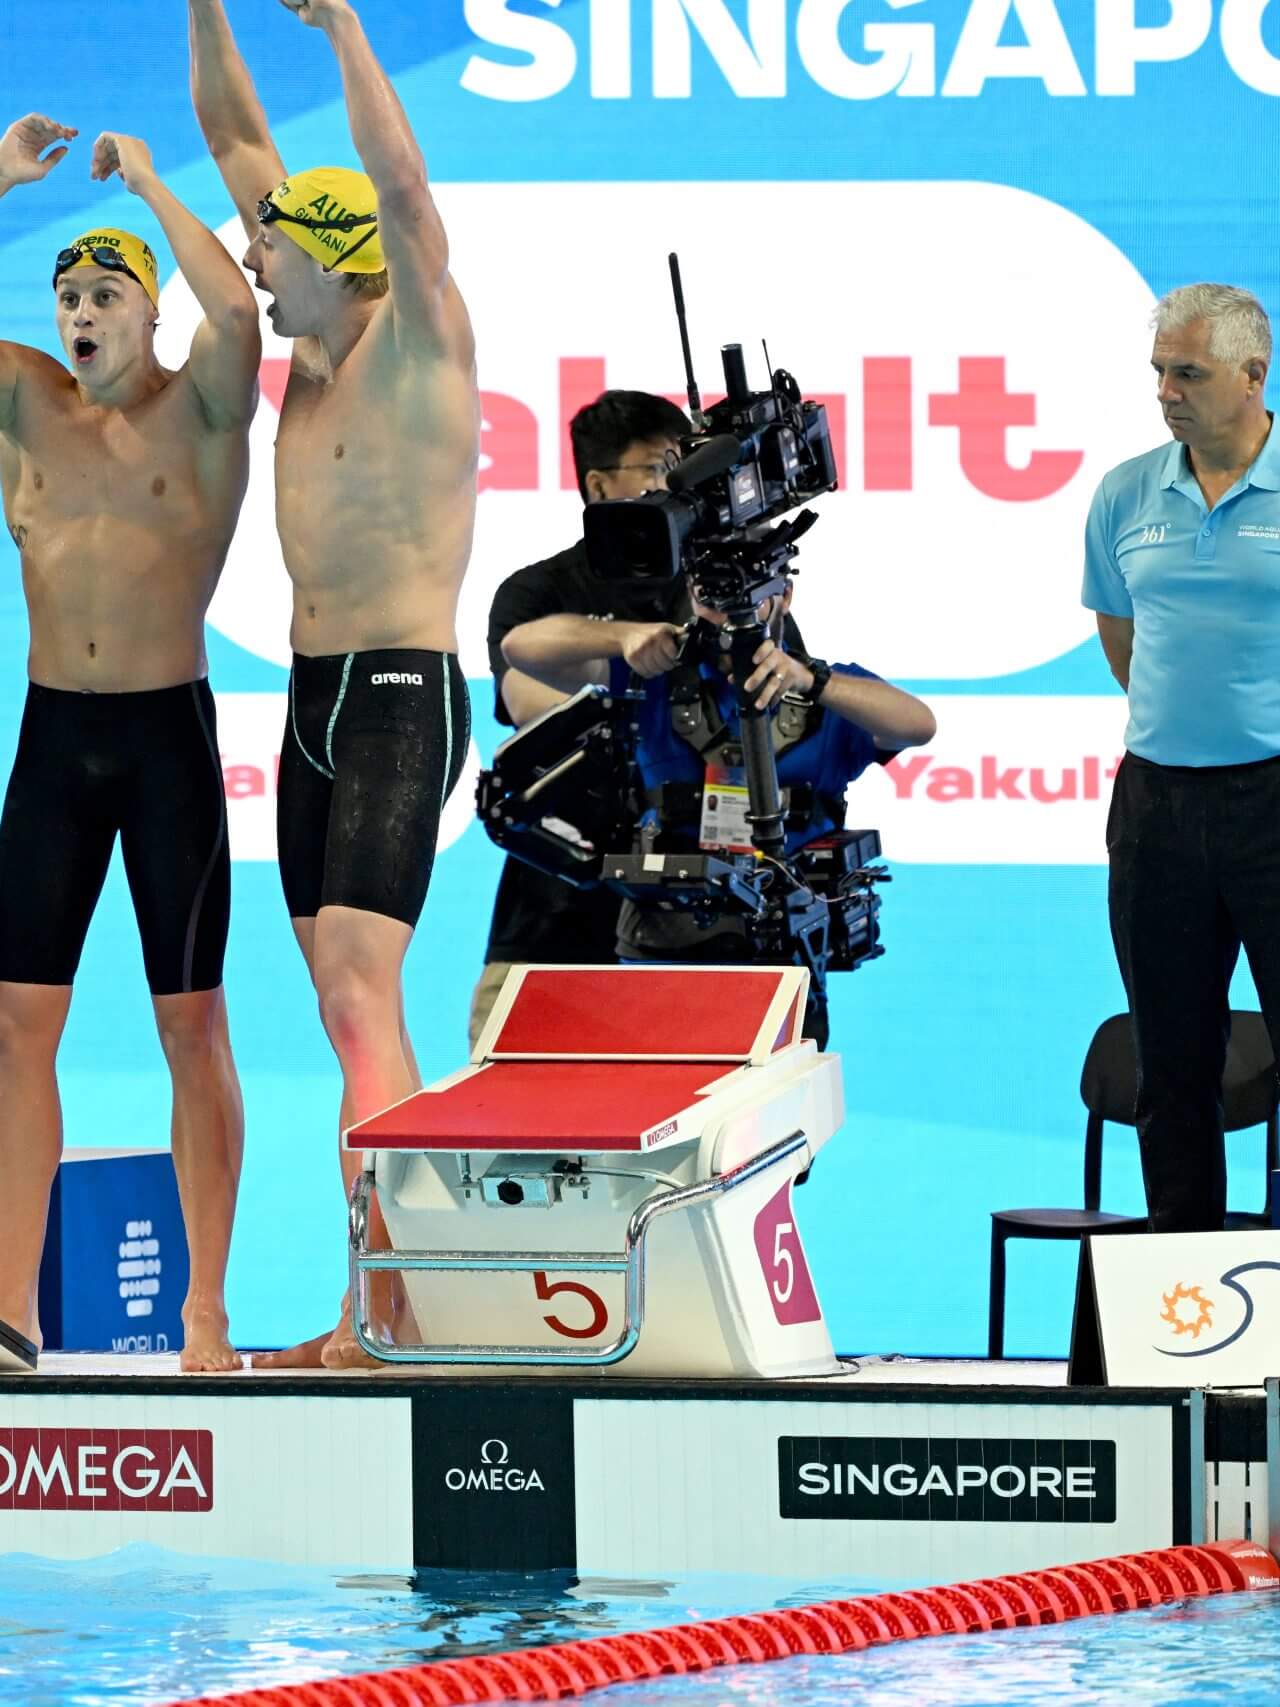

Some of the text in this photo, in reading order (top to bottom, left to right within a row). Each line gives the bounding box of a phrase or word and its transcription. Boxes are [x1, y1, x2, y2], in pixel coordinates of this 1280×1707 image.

[295, 208, 347, 253] GILIANI
[371, 672, 423, 686] arena
[773, 1222, 793, 1304] 5
[533, 1271, 608, 1339] 5
[111, 1333, 169, 1352] WORLD
[445, 1467, 545, 1491] OMEGA
[798, 1462, 1097, 1498] SINGAPORE
